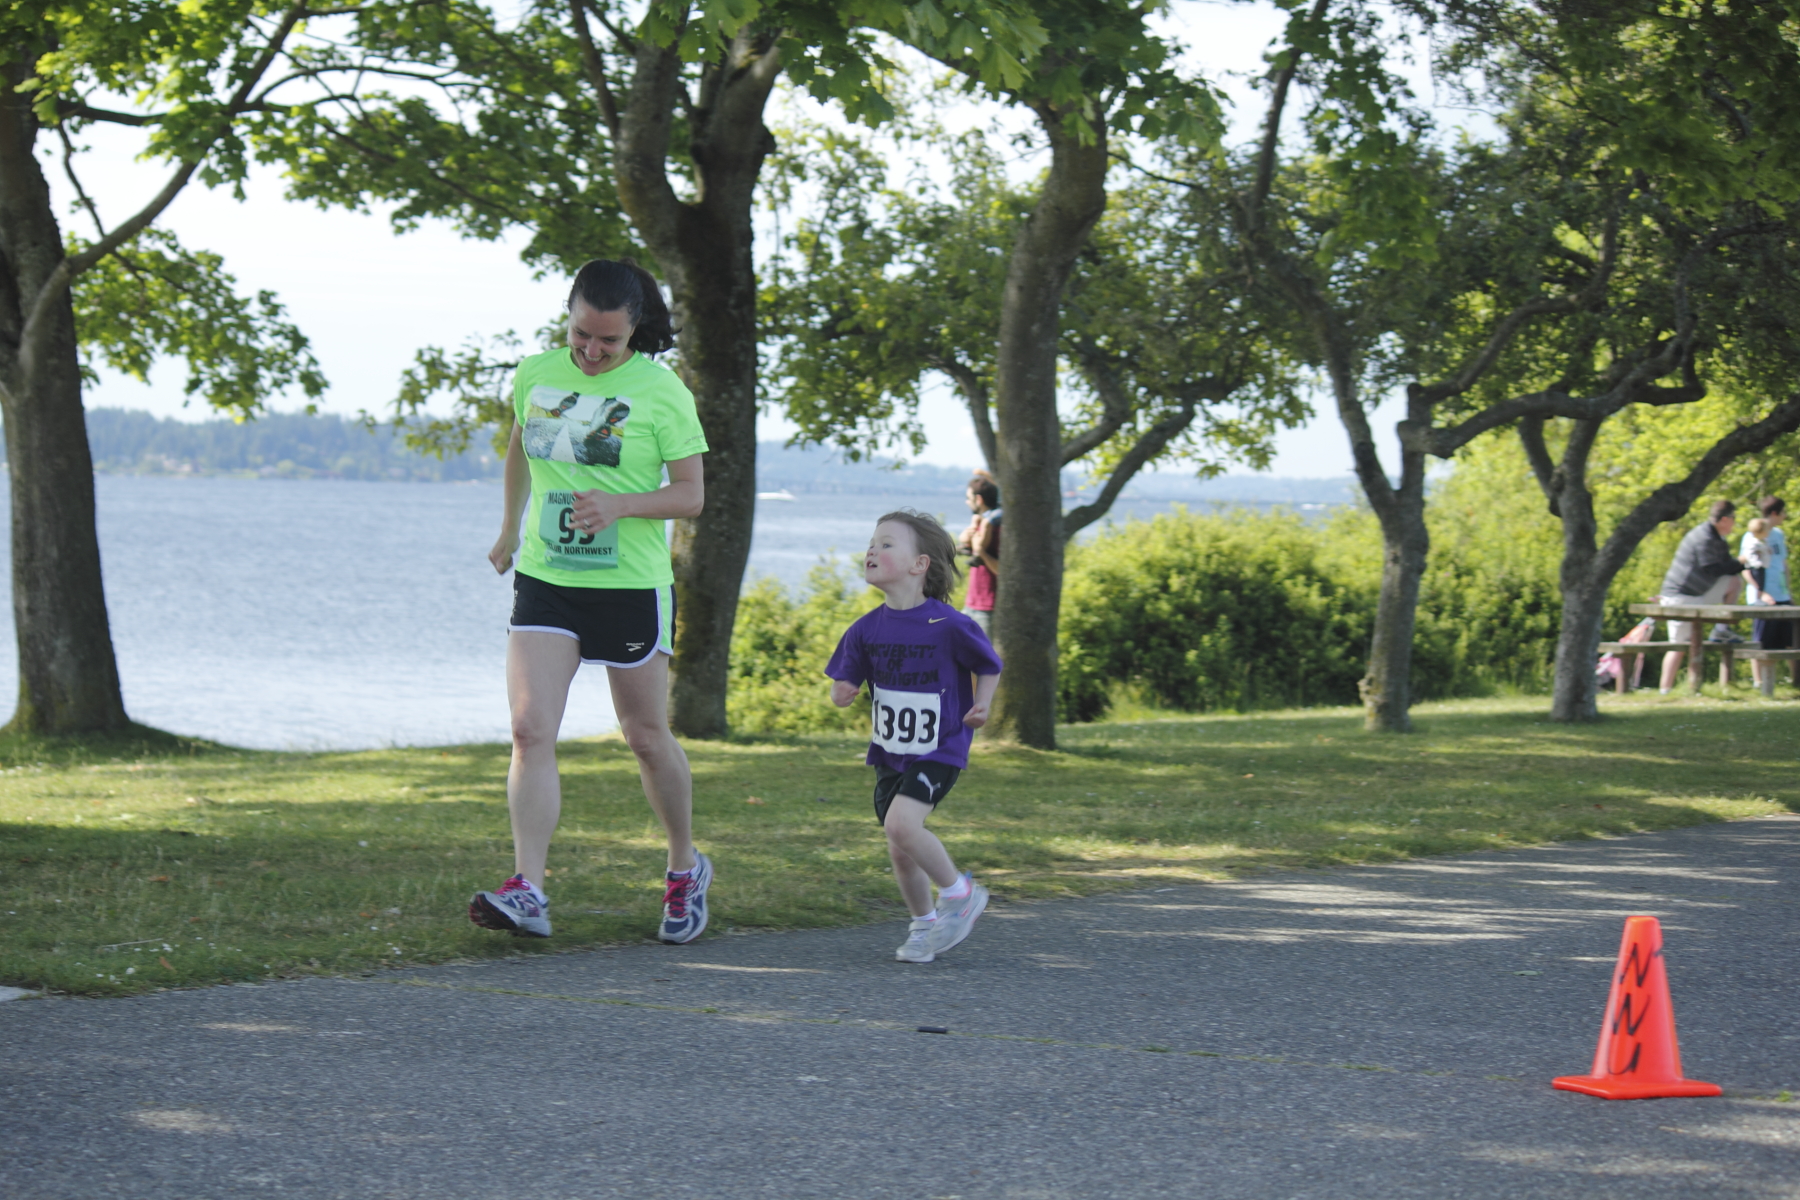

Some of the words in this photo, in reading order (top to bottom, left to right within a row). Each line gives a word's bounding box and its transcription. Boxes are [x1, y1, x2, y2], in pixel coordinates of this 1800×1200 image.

[564, 546, 612, 555] NORTHWEST
[887, 658, 903, 672] OF
[875, 670, 938, 686] SHINGTON
[874, 700, 936, 744] 1393
